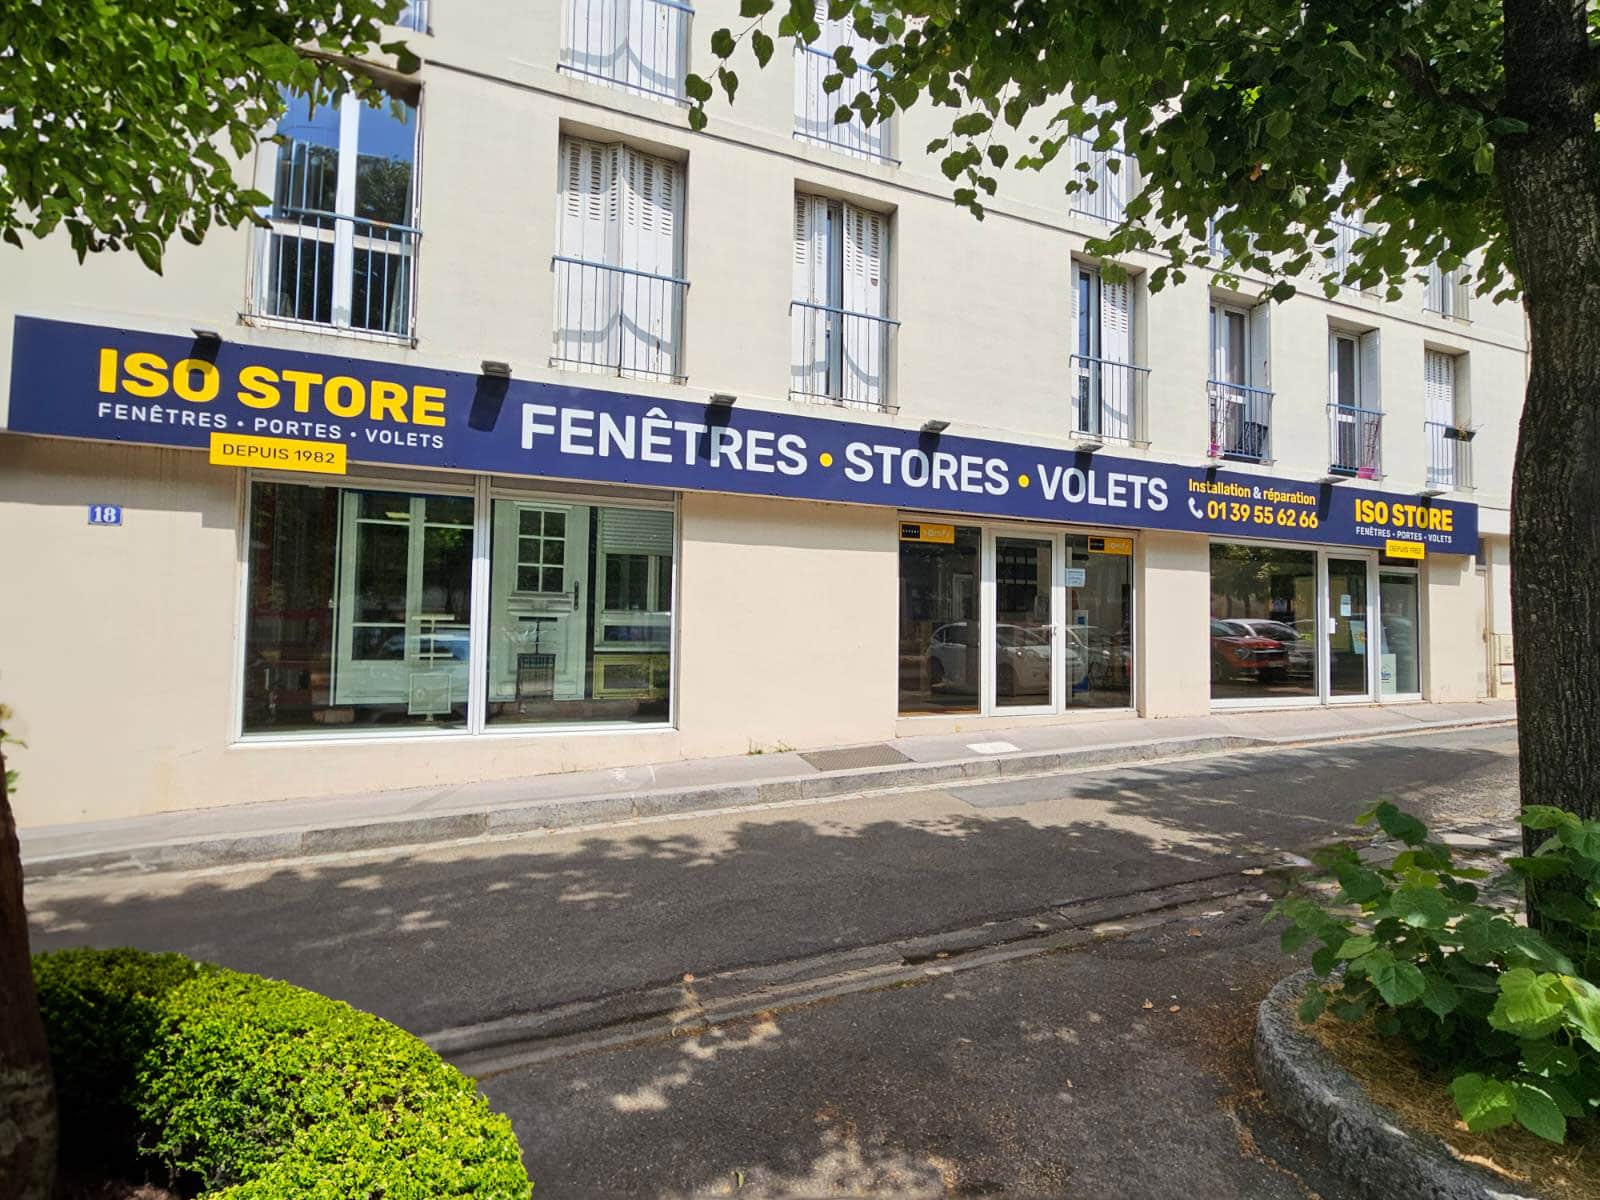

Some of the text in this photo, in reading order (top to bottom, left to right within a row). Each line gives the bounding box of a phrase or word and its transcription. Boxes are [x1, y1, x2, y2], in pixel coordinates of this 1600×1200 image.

[98, 347, 447, 428] ISO STORE
[98, 402, 445, 450] FENÊTRES PORTES VOLETS
[222, 443, 335, 464] DEPUIS 1982
[521, 403, 1169, 512] FENÊTRES STORES VOLETS
[1188, 478, 1316, 506] Installation & réparation
[95, 506, 117, 522] 18
[1207, 500, 1319, 529] 01 39 55 62 66
[1355, 498, 1453, 532] ISO STORE
[1355, 526, 1453, 544] FENÊTRES PORTES VOLETS
